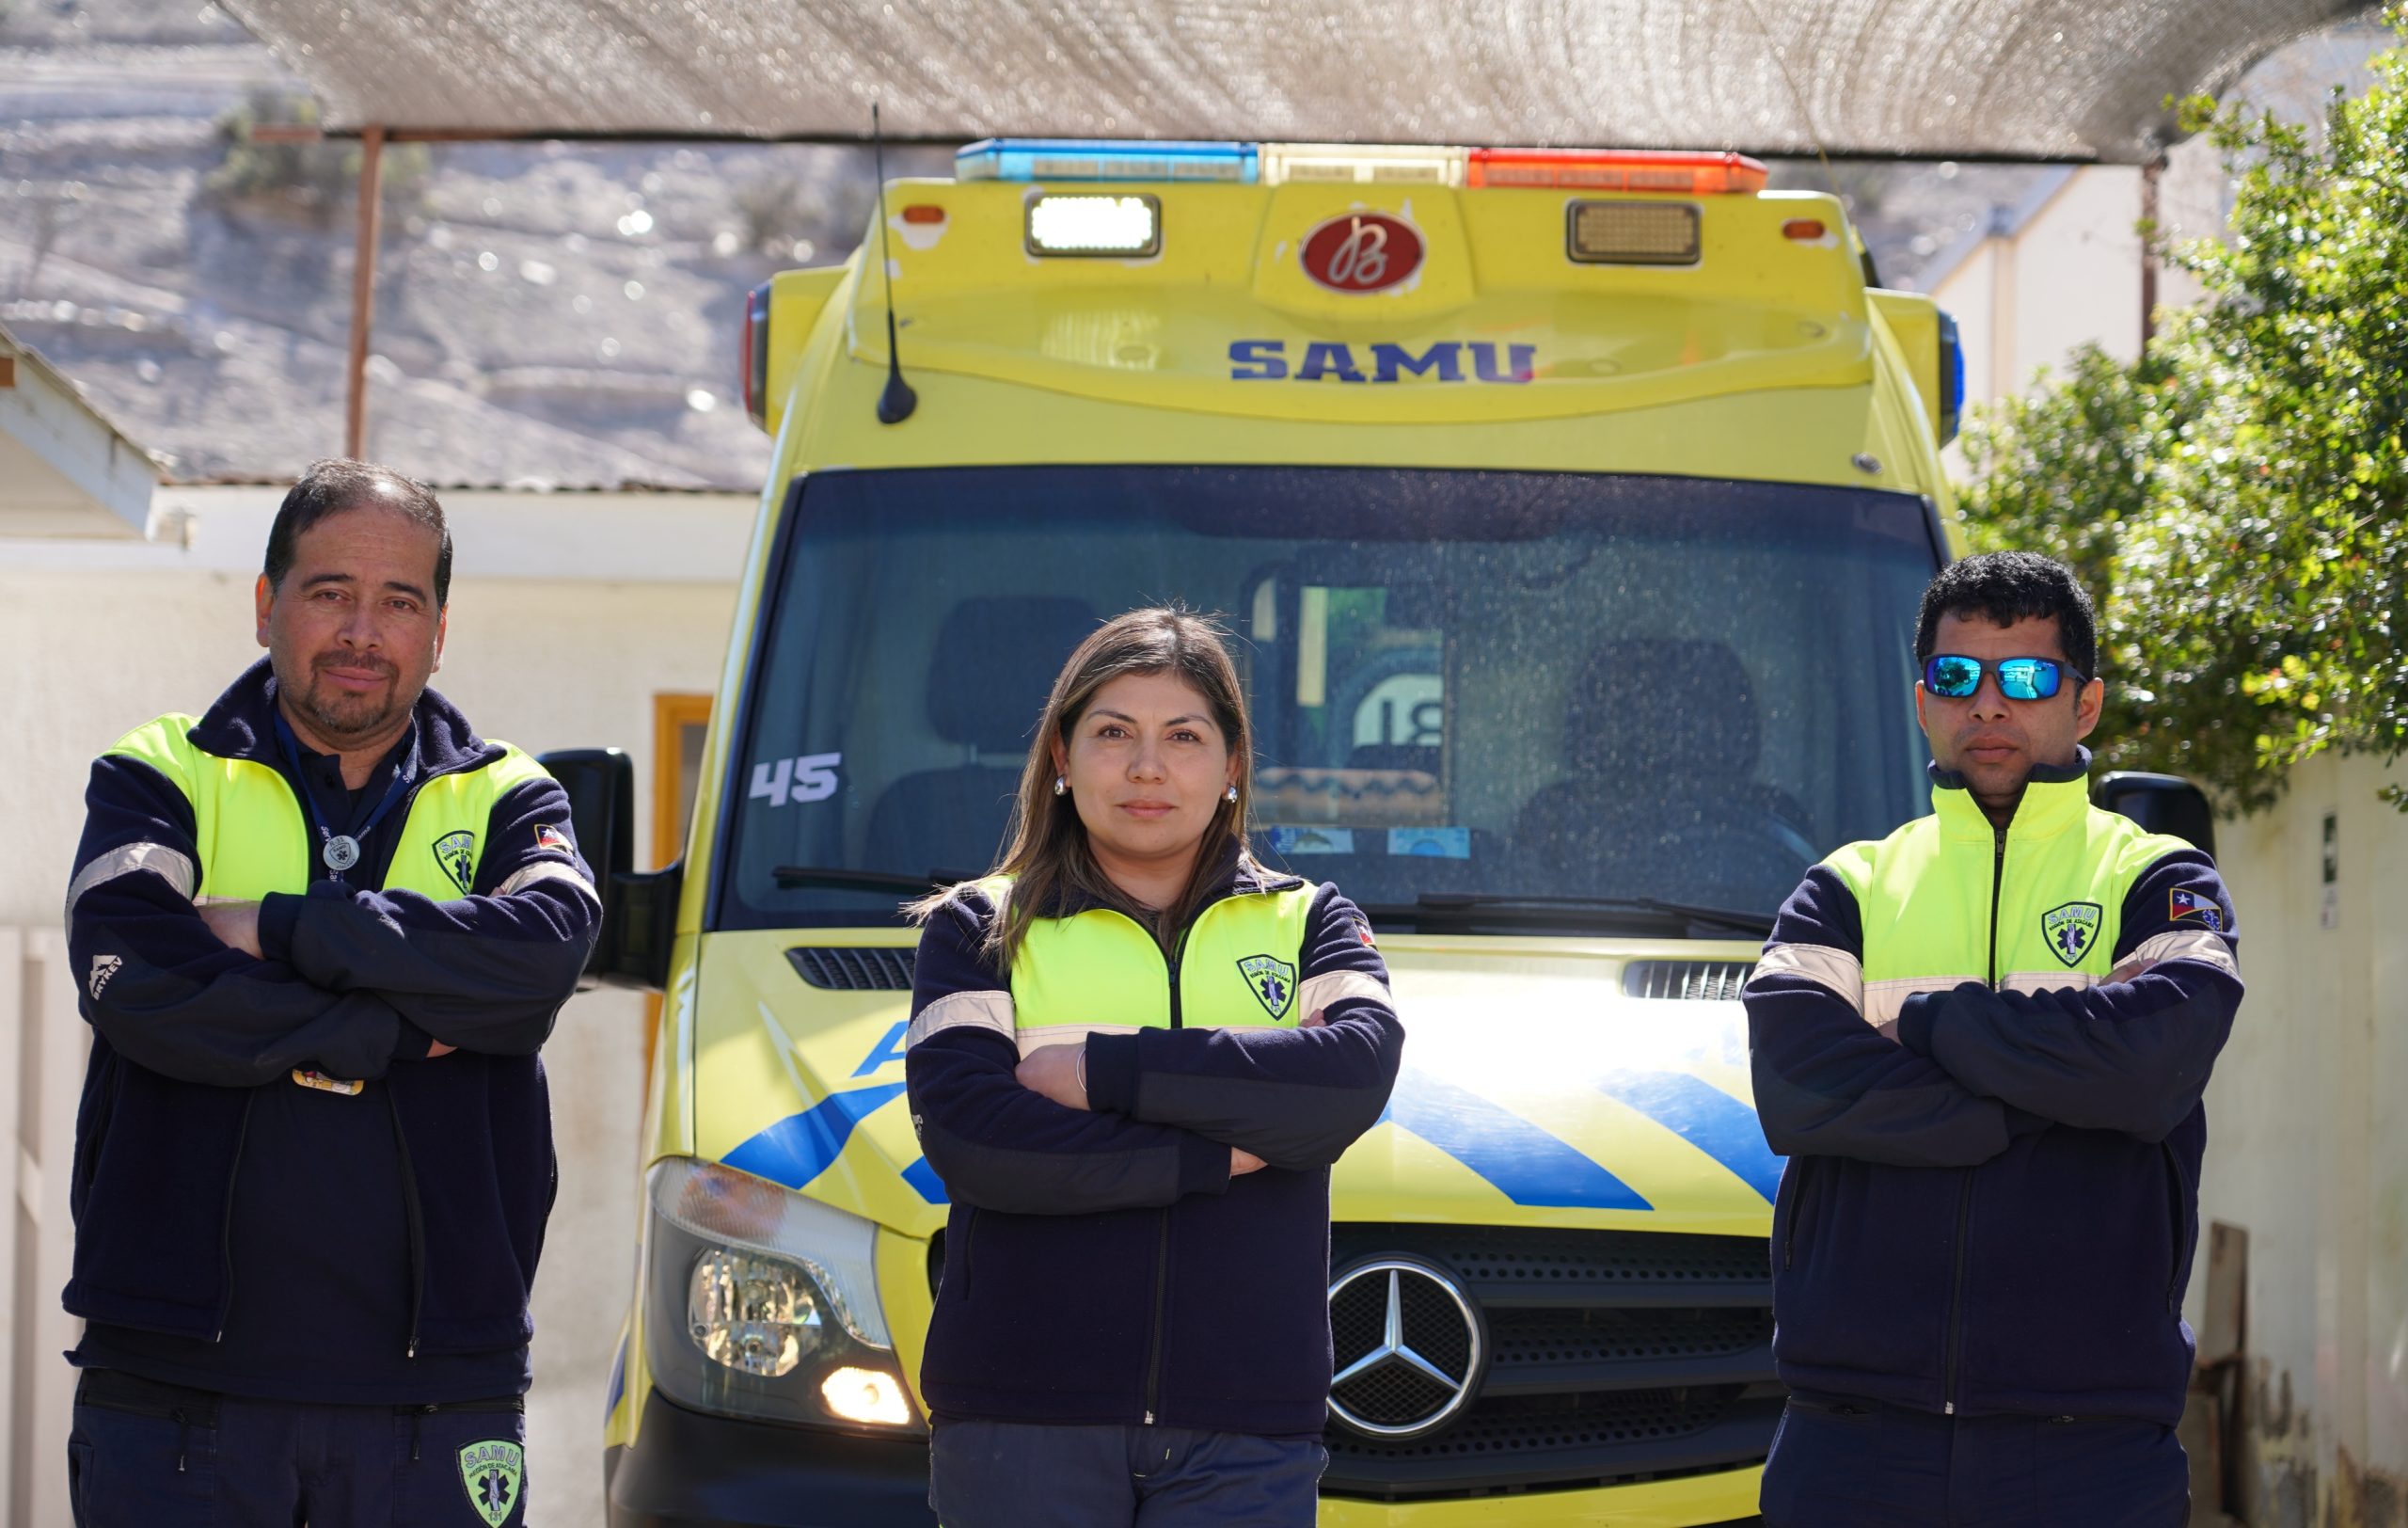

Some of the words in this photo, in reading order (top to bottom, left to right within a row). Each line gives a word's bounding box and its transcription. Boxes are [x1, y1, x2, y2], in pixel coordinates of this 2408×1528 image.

[1228, 340, 1537, 383] SAMU
[749, 752, 842, 807] 45
[2049, 906, 2097, 924] SAMU
[1244, 959, 1289, 976] SAMU
[464, 1444, 519, 1468] SAMU
[496, 1462, 517, 1477] ATACAMA
[488, 1511, 502, 1521] 131
